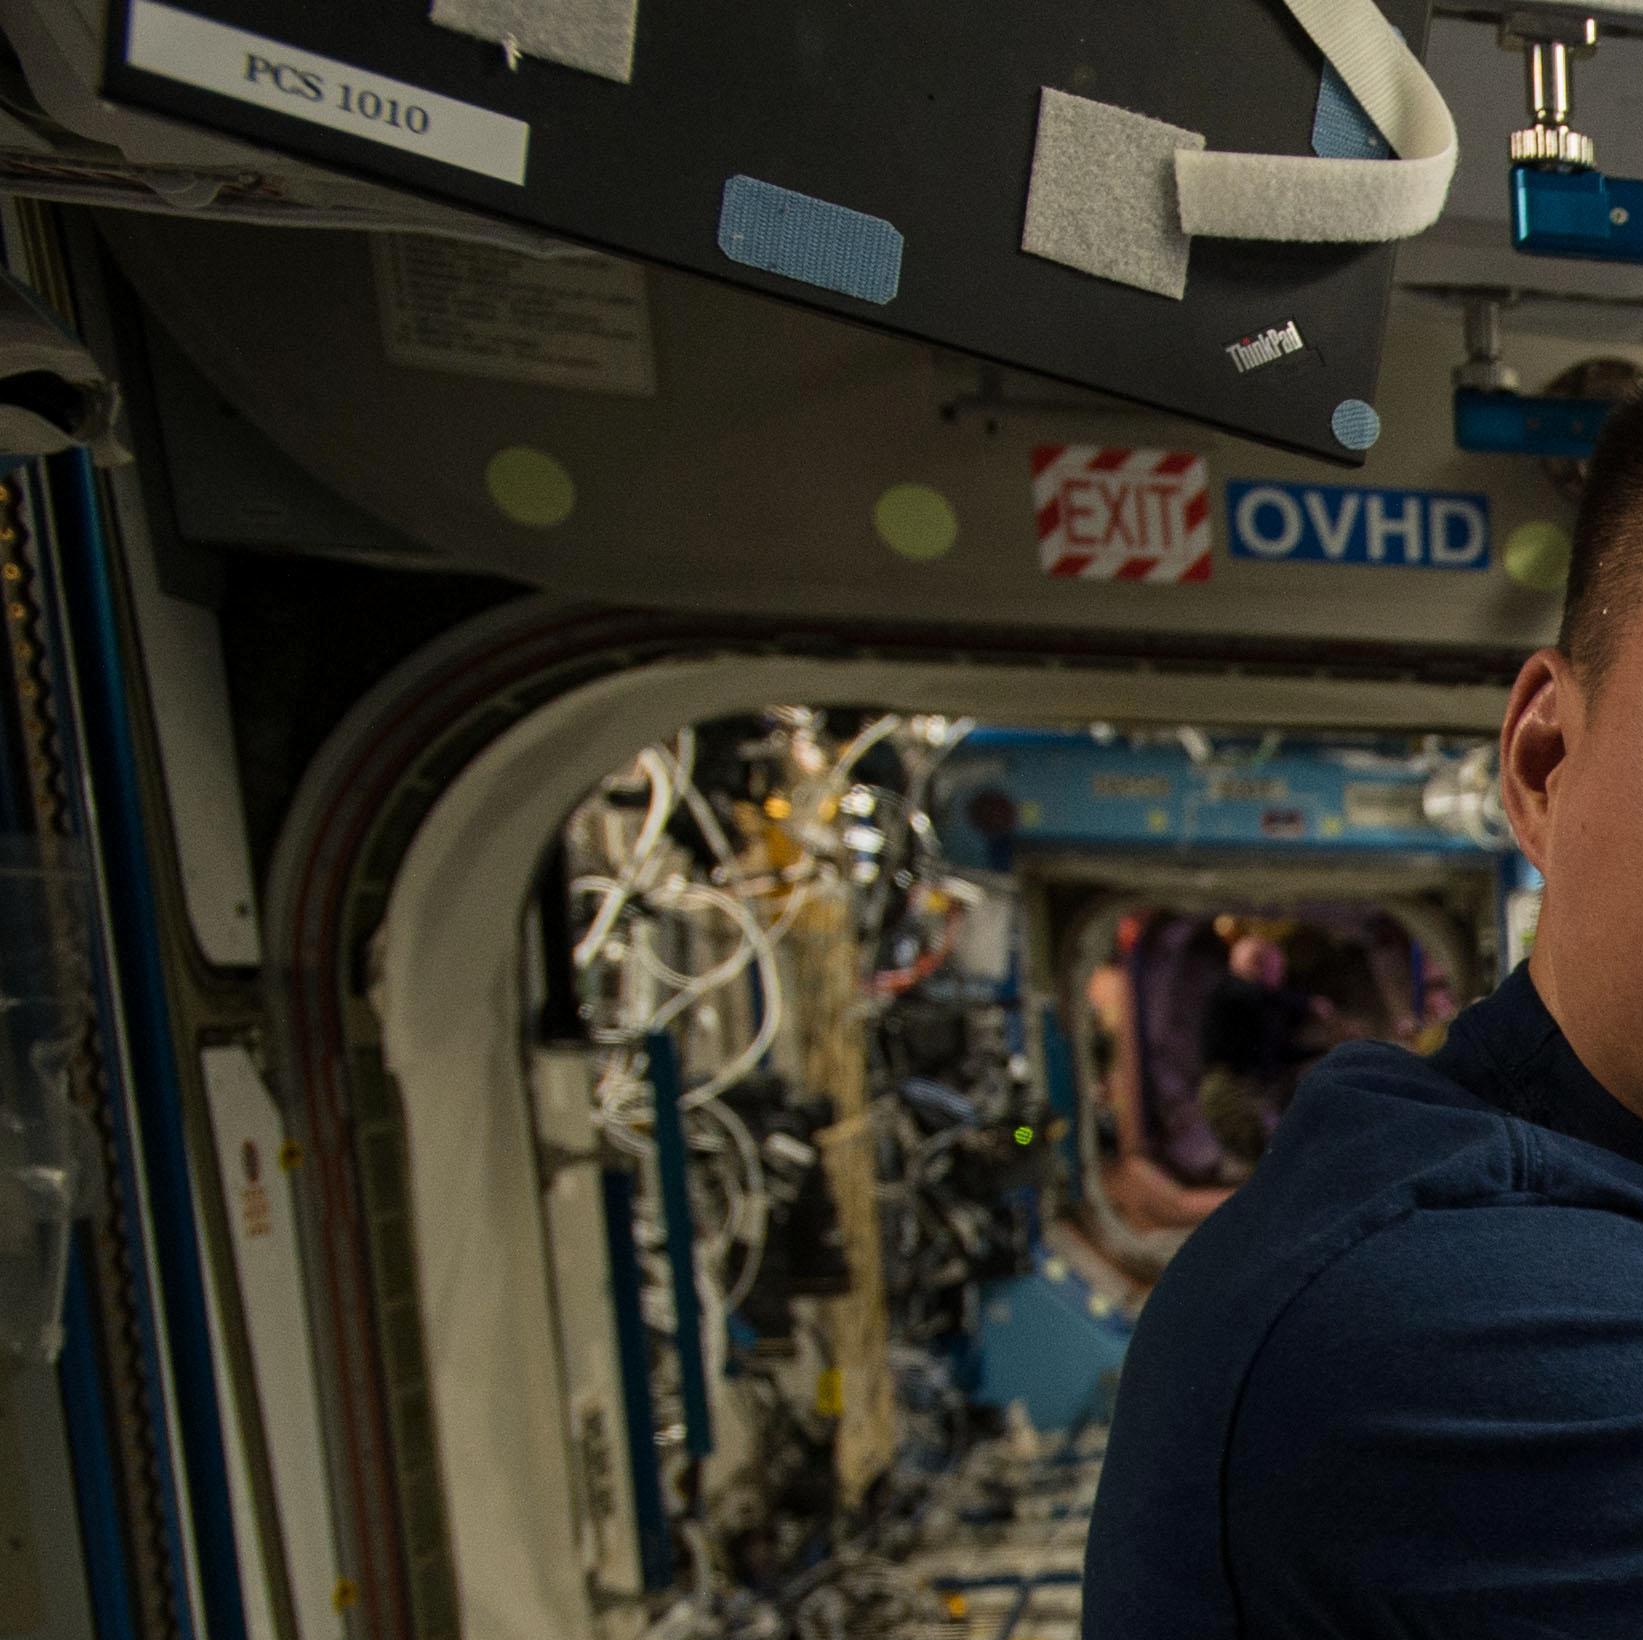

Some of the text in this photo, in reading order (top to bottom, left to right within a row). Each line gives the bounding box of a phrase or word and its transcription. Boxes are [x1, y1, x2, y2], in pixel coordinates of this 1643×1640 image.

[244, 53, 430, 135] PCS 1010
[1225, 320, 1304, 374] ThinkPad
[1062, 478, 1488, 563] EXIT OVHD
